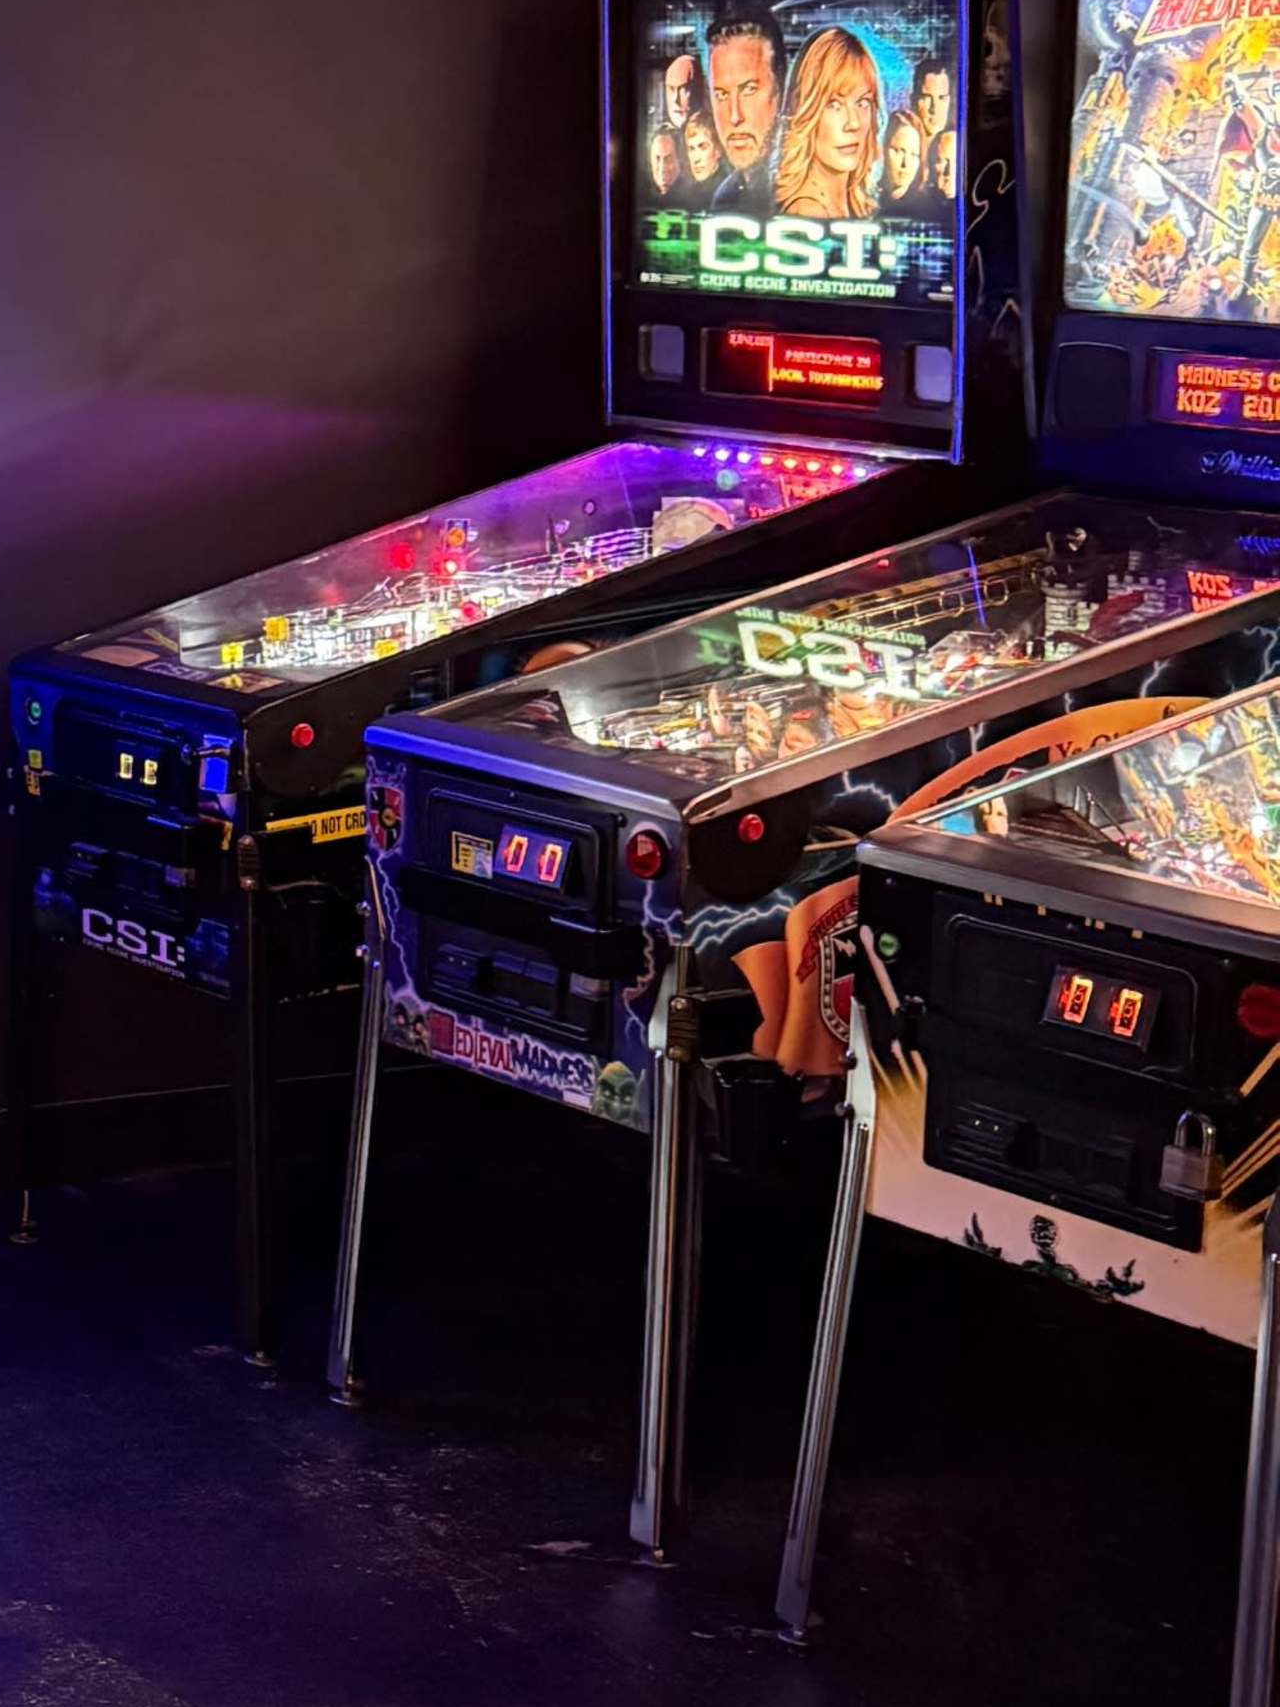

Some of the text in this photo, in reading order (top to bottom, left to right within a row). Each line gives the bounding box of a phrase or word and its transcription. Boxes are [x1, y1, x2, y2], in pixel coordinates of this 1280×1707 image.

[699, 272, 740, 289] CRIME
[744, 276, 787, 292] SCENE
[790, 278, 897, 298] INVESTIGATION
[1177, 363, 1264, 390] MADNESS
[321, 815, 343, 835] NOT
[344, 811, 367, 831] CRO
[81, 907, 186, 967] CSI:
